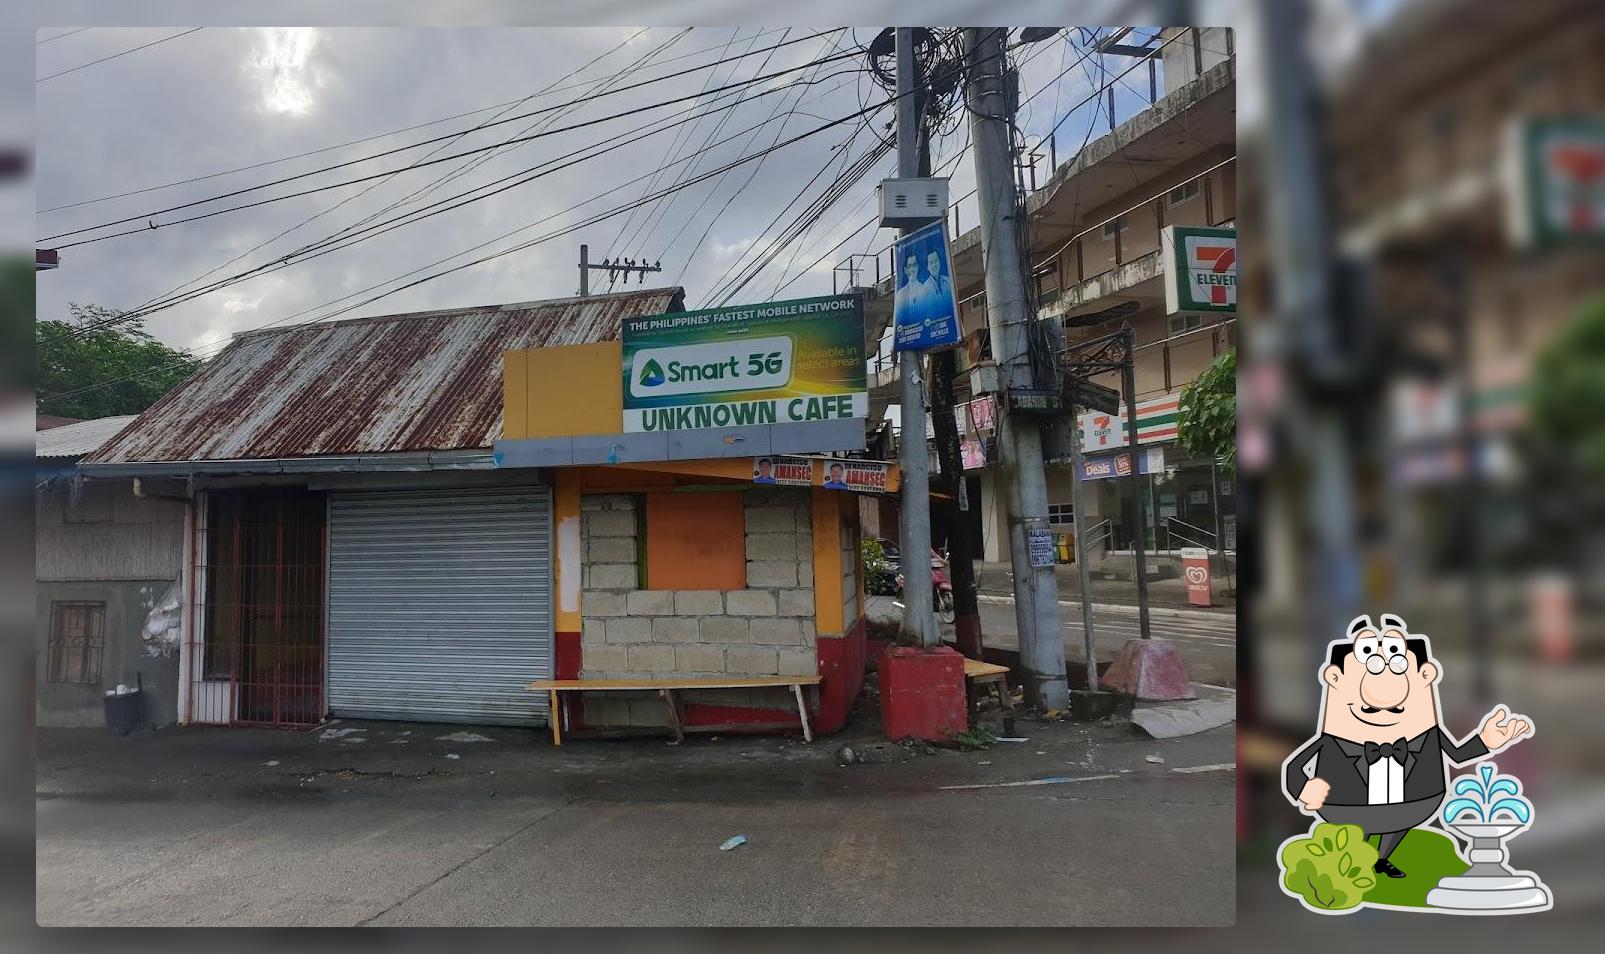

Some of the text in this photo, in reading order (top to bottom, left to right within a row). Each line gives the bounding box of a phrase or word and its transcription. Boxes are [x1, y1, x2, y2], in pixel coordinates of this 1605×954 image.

[1196, 247, 1236, 303] 7
[629, 321, 649, 331] THE
[650, 316, 712, 330] PHILIPPINES'
[714, 310, 756, 323] FASTEST
[757, 305, 797, 318] MOBILE
[799, 299, 855, 314] NETWORK
[798, 347, 844, 360] Available
[831, 358, 860, 368] areas
[668, 352, 783, 383] Smart 5G
[642, 395, 853, 432] UNKNOWN CAFE
[846, 470, 885, 487] AMANSEC
[1086, 463, 1110, 476] Deals
